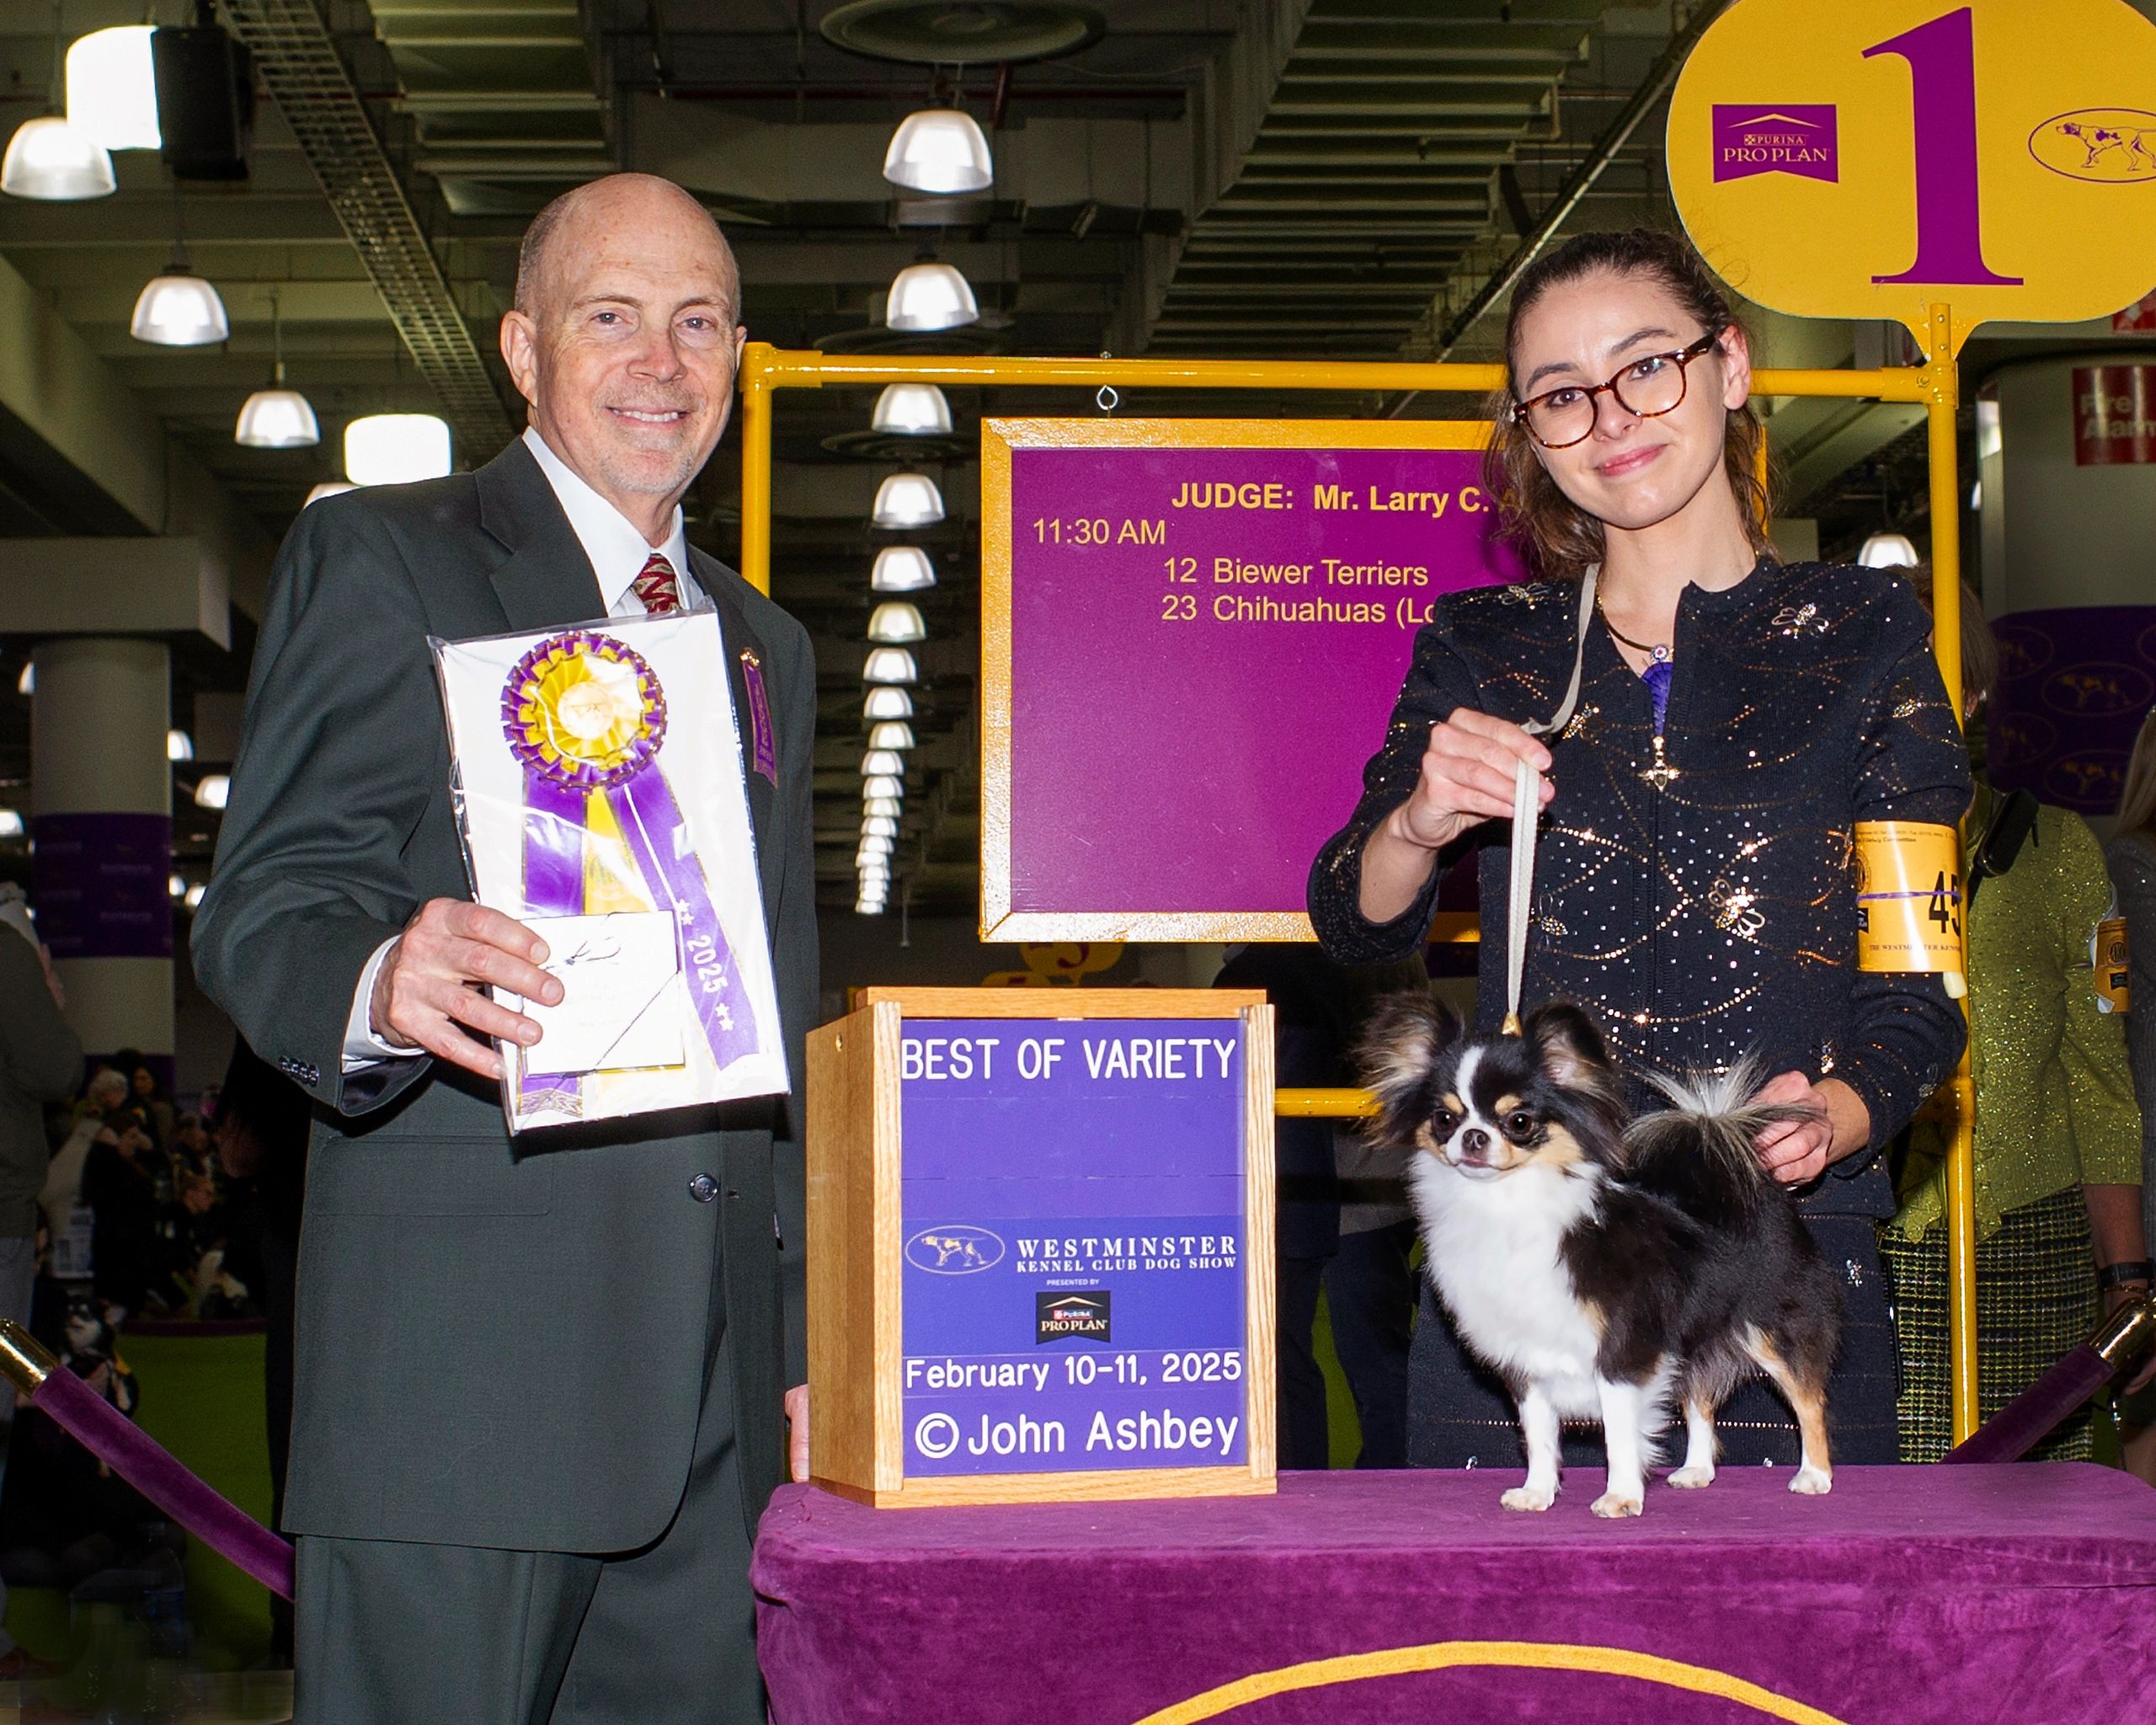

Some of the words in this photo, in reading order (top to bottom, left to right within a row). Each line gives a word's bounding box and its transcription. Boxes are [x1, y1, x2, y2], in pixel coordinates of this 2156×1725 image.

[1757, 135, 1804, 145] PURINA
[1860, 6, 2025, 286] 1
[1723, 147, 1768, 163] PRO
[1771, 147, 1828, 163] PLAN
[1171, 482, 1293, 510] JUDGE:
[1314, 484, 1359, 510] Mr.
[1369, 485, 1449, 519] Larry
[1459, 486, 1490, 513] C.
[1033, 518, 1111, 545] 11:30
[1117, 519, 1166, 545] AM
[1164, 557, 1198, 584] 12
[1214, 558, 1314, 585] Biewer
[1321, 558, 1429, 586] Terriers
[1161, 594, 1198, 621] 23
[1213, 595, 1386, 623] Chihuahuas
[686, 934, 728, 994] 2025
[901, 1038, 1001, 1080] BEST
[1017, 1038, 1065, 1080] OF
[1082, 1039, 1236, 1079] VARIETY
[1017, 1236, 1236, 1258] WESTMINSTER
[1017, 1258, 1085, 1273] KENNEL
[1092, 1258, 1138, 1271] CLUB
[1145, 1258, 1181, 1270] DOG
[1189, 1257, 1236, 1269] SHOW
[1041, 1320, 1069, 1332] PRO
[1070, 1319, 1106, 1331] PLAN
[905, 1359, 1050, 1391] February
[1065, 1354, 1148, 1386] 10-11,
[1162, 1351, 1242, 1382] 2025
[1086, 1408, 1239, 1456] Ashbey
